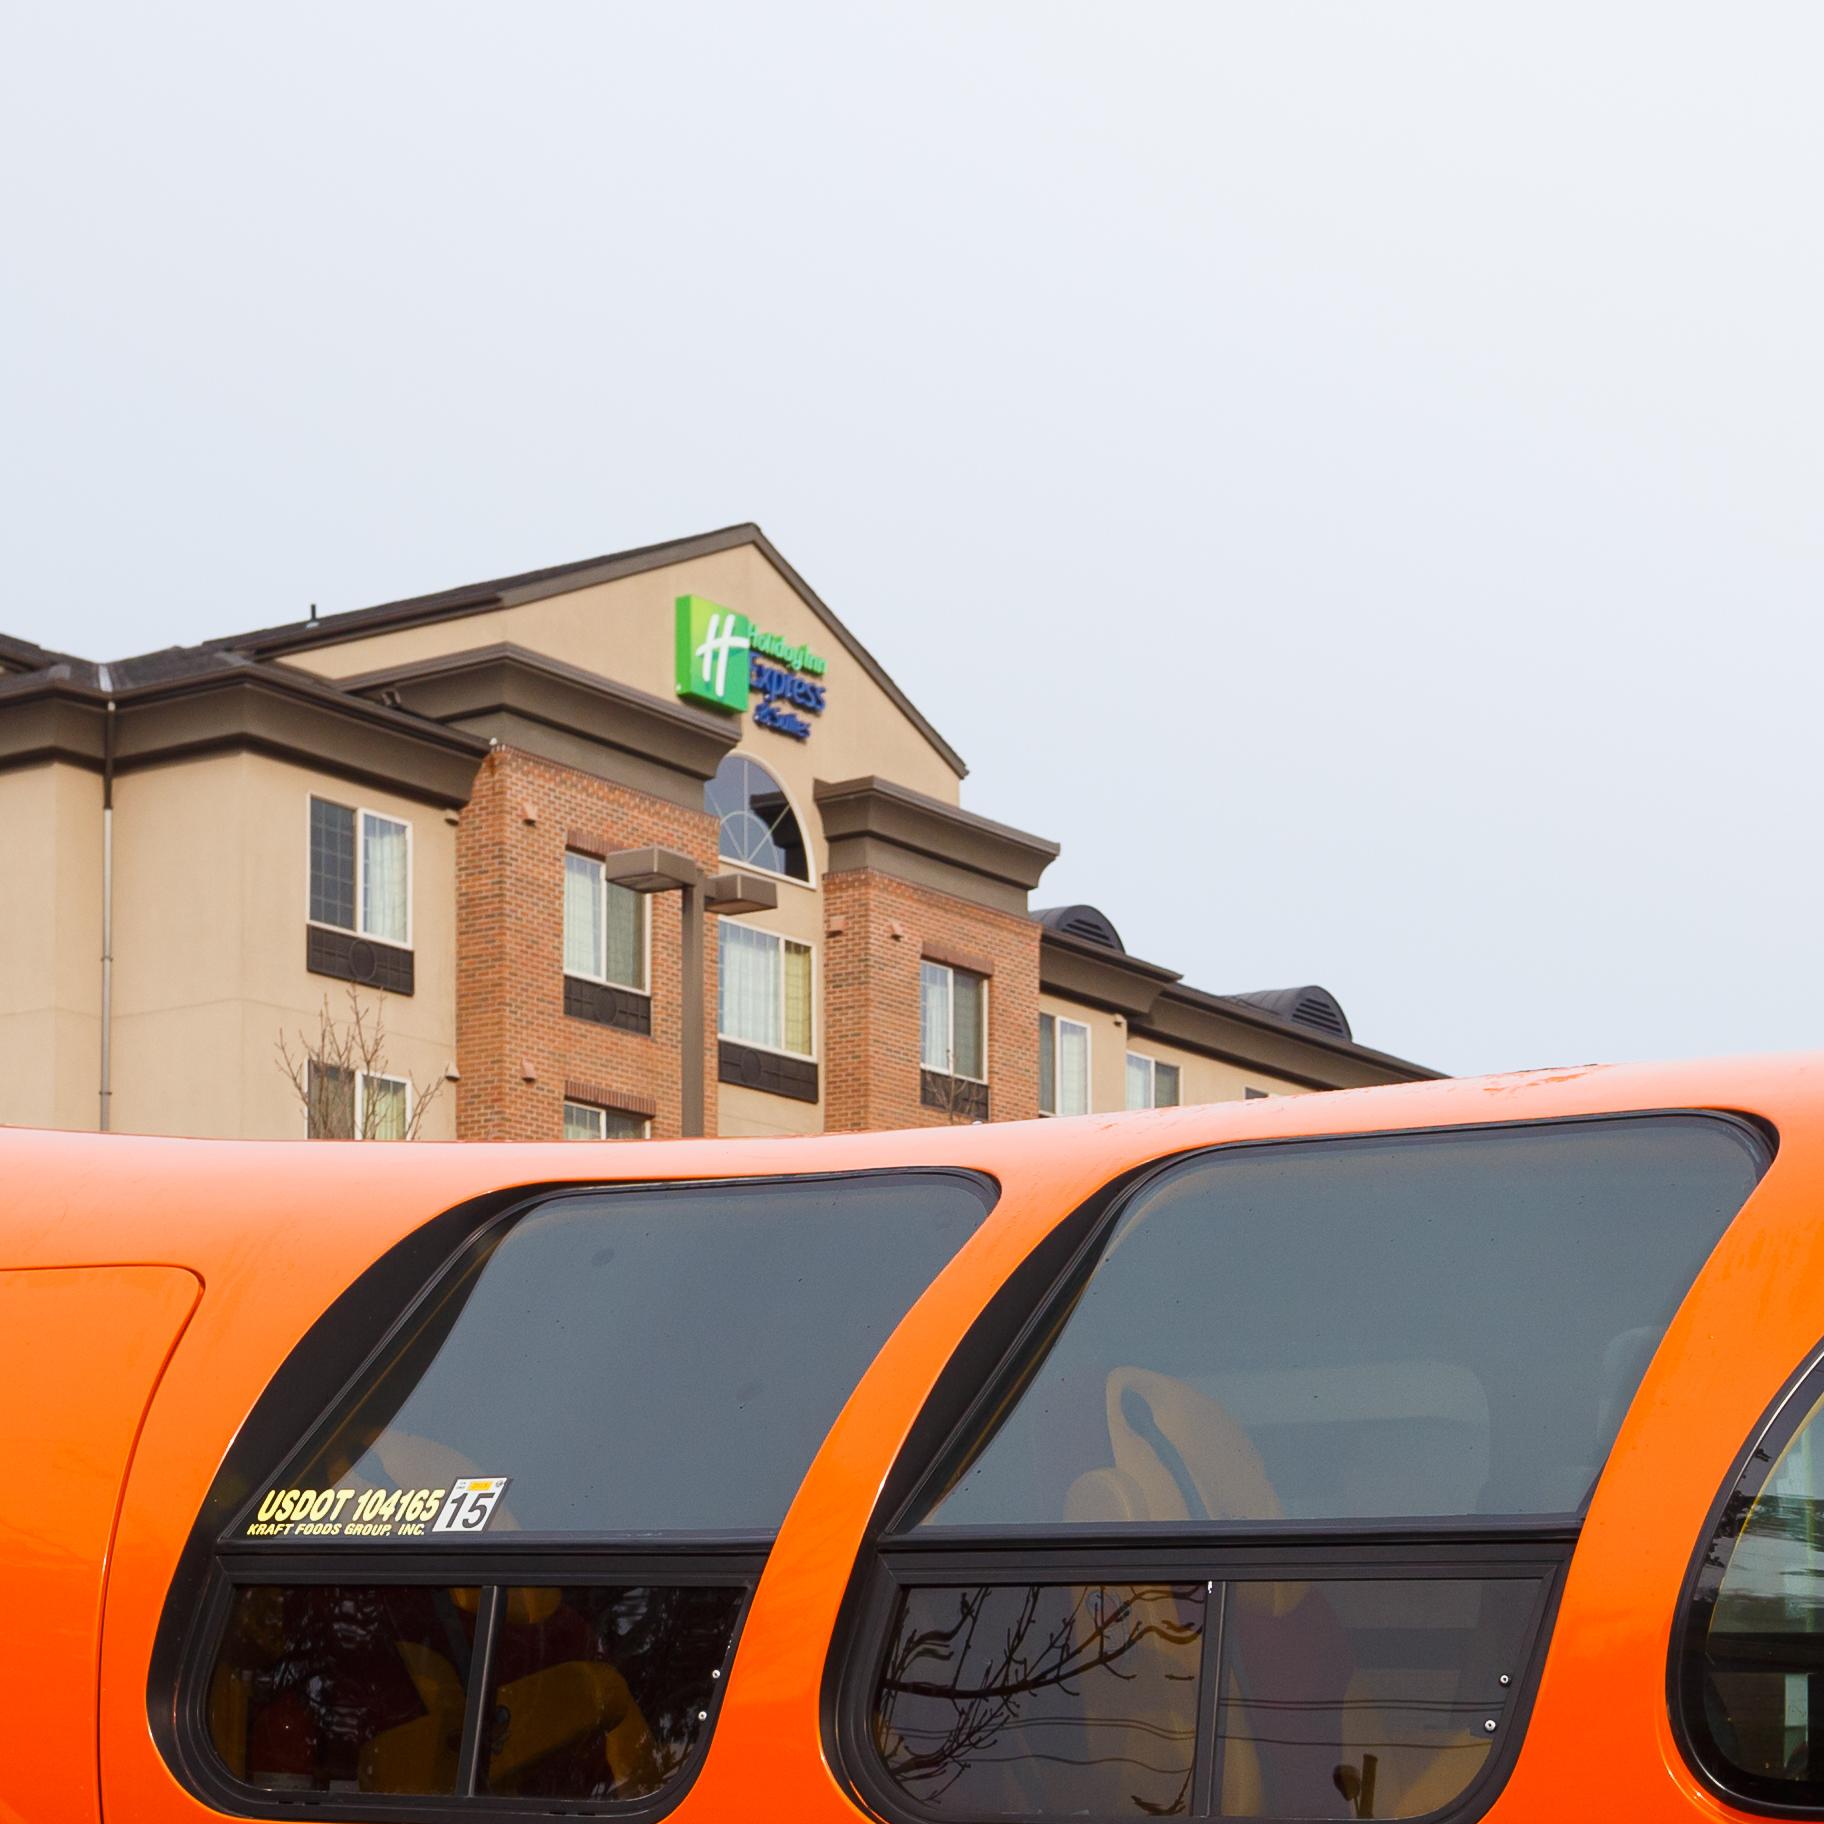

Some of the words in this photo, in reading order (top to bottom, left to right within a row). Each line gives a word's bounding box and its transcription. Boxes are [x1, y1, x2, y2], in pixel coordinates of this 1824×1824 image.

[748, 623, 805, 671] Holiday
[750, 650, 826, 712] Express
[257, 1489, 355, 1522] USDOT
[352, 1488, 446, 1522] 104165
[445, 1492, 496, 1529] 15
[246, 1523, 295, 1536] KRAFT
[295, 1523, 343, 1536] FOODS
[397, 1523, 425, 1536] INC.
